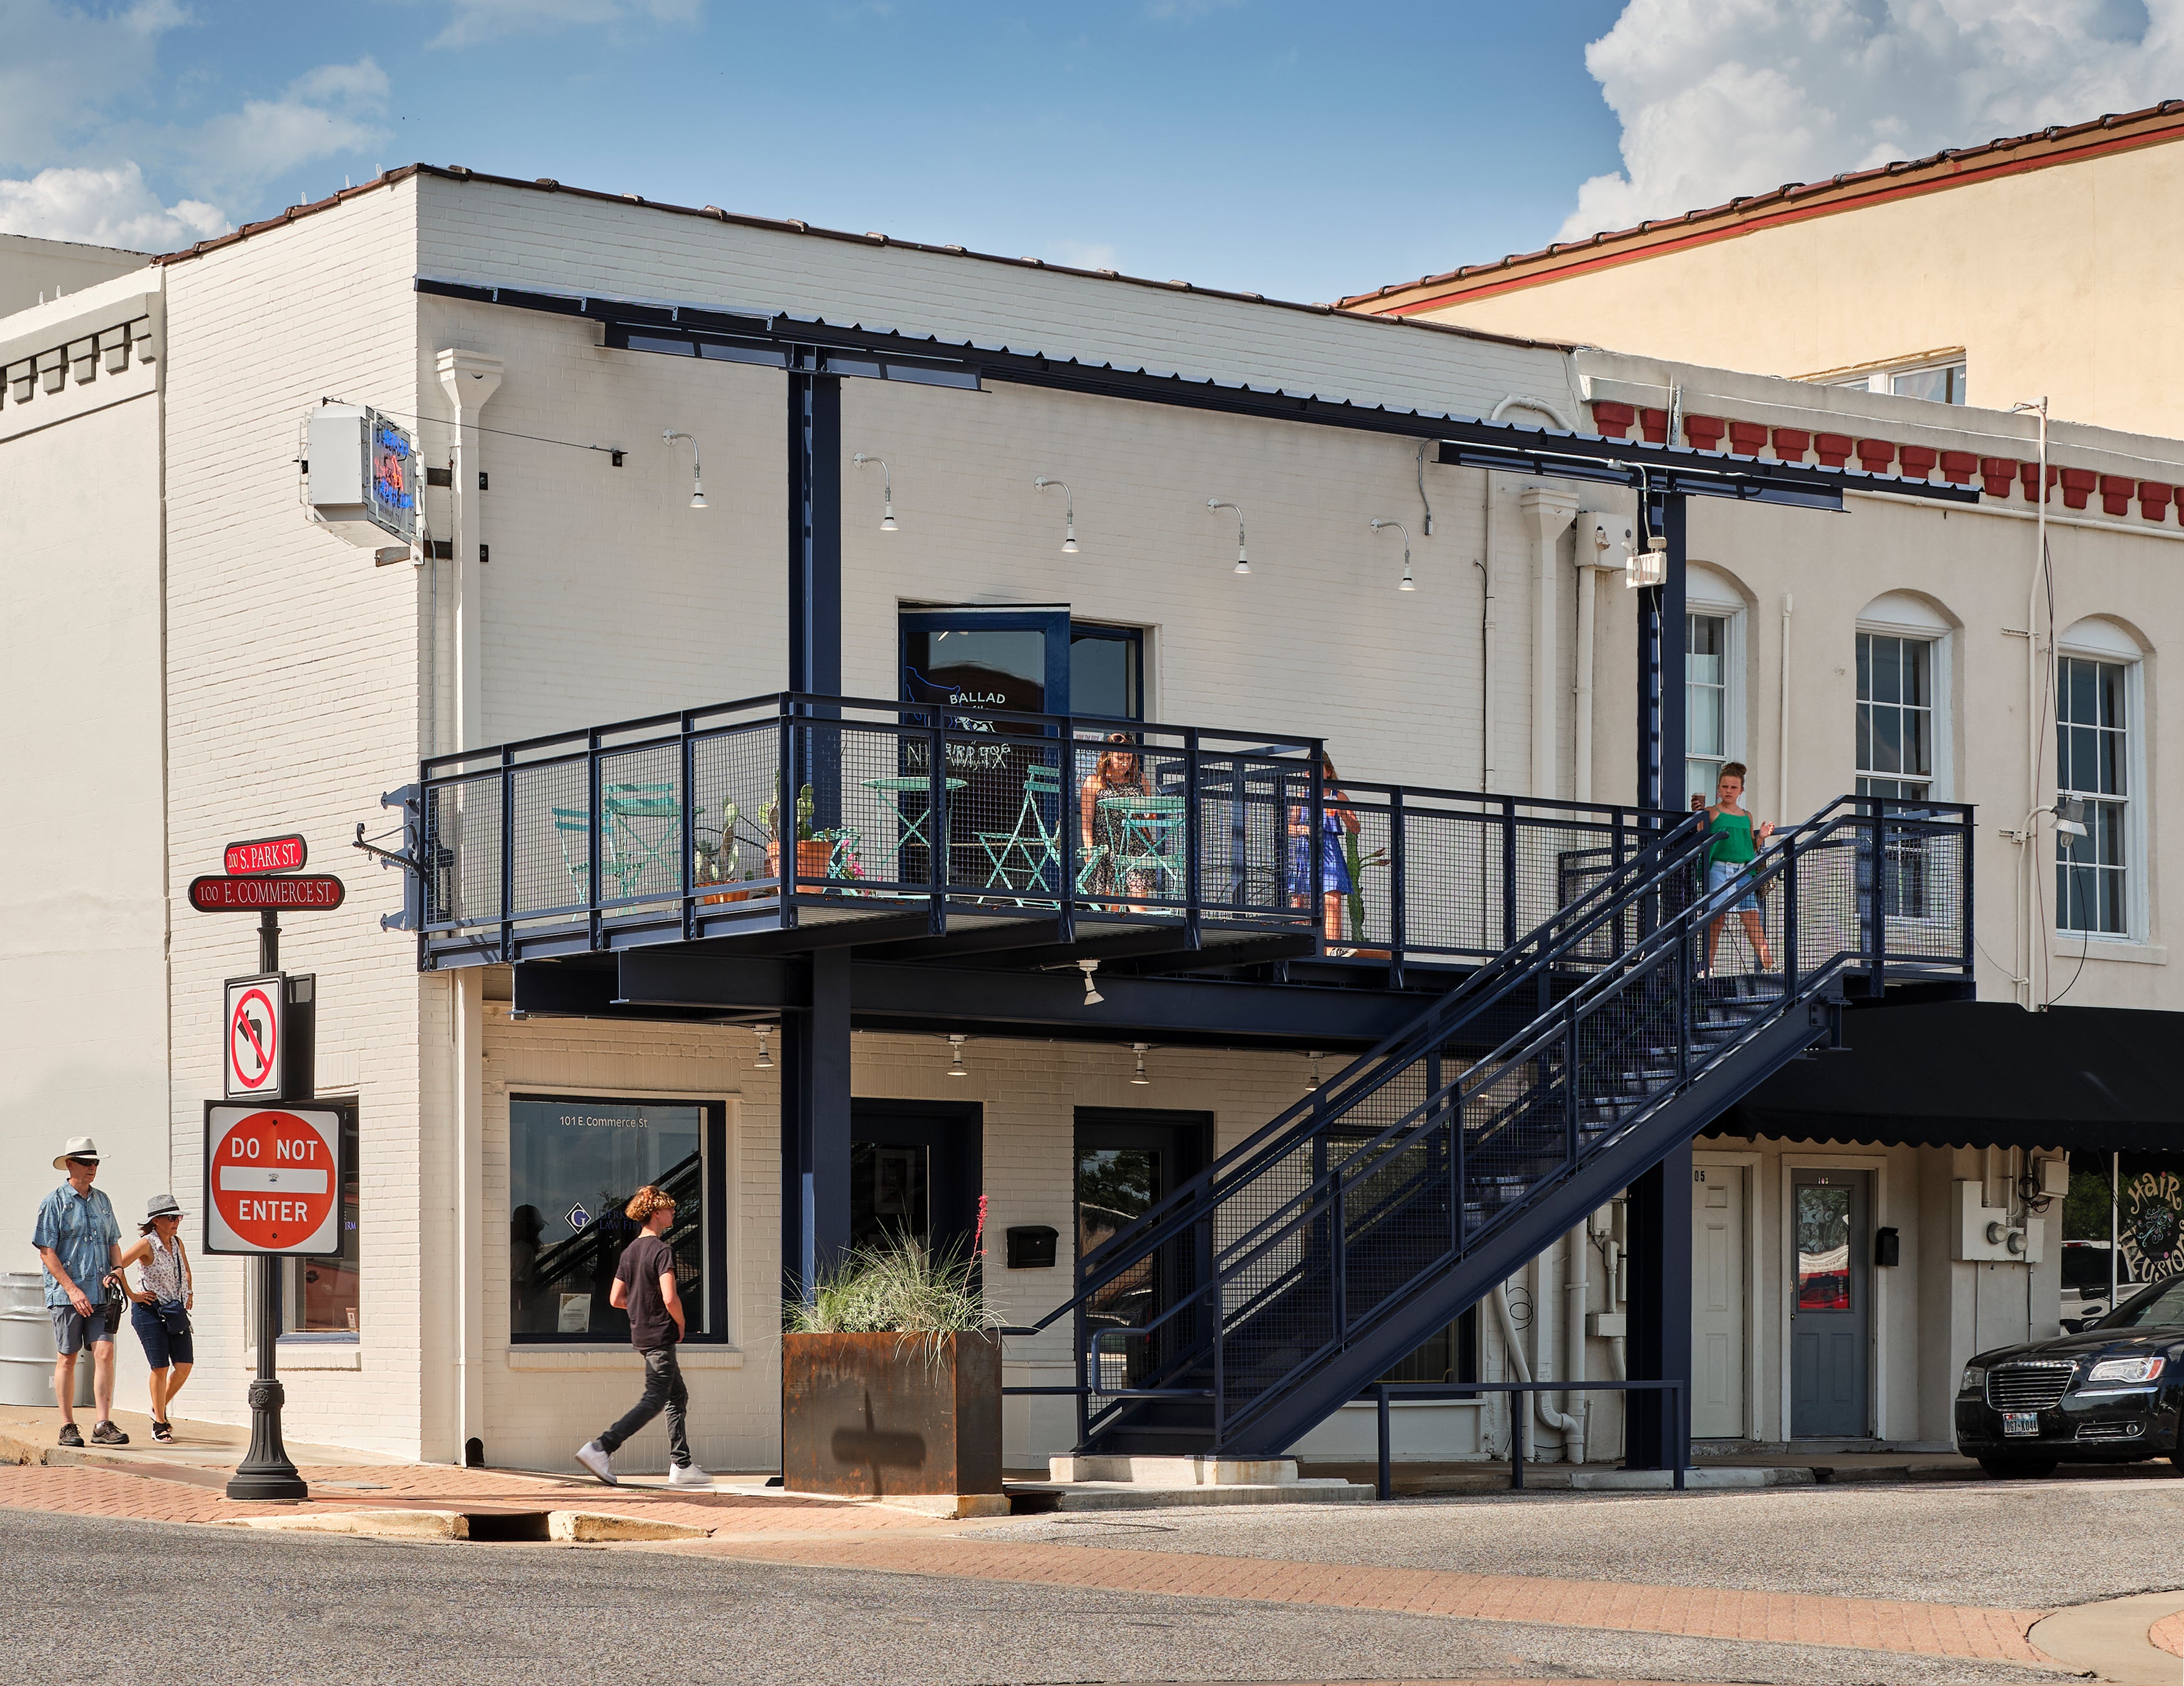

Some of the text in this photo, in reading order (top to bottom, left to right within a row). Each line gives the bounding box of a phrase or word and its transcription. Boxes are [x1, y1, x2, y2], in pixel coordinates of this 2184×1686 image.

[1632, 555, 1655, 582] EXIT
[949, 691, 1006, 704] BALLAD
[228, 843, 299, 869] 200 S. PARK ST.
[200, 881, 335, 904] 100 E. COMMERCE ST.
[559, 1116, 575, 1126] 101
[578, 1116, 585, 1126] E.
[586, 1116, 636, 1128] Commerce
[232, 1137, 318, 1161] DO NOT
[1694, 1170, 1705, 1182] 05
[239, 1199, 308, 1222] ENTER
[599, 1210, 629, 1219] GERK
[344, 1221, 357, 1231] IRM
[600, 1219, 620, 1229] LAW
